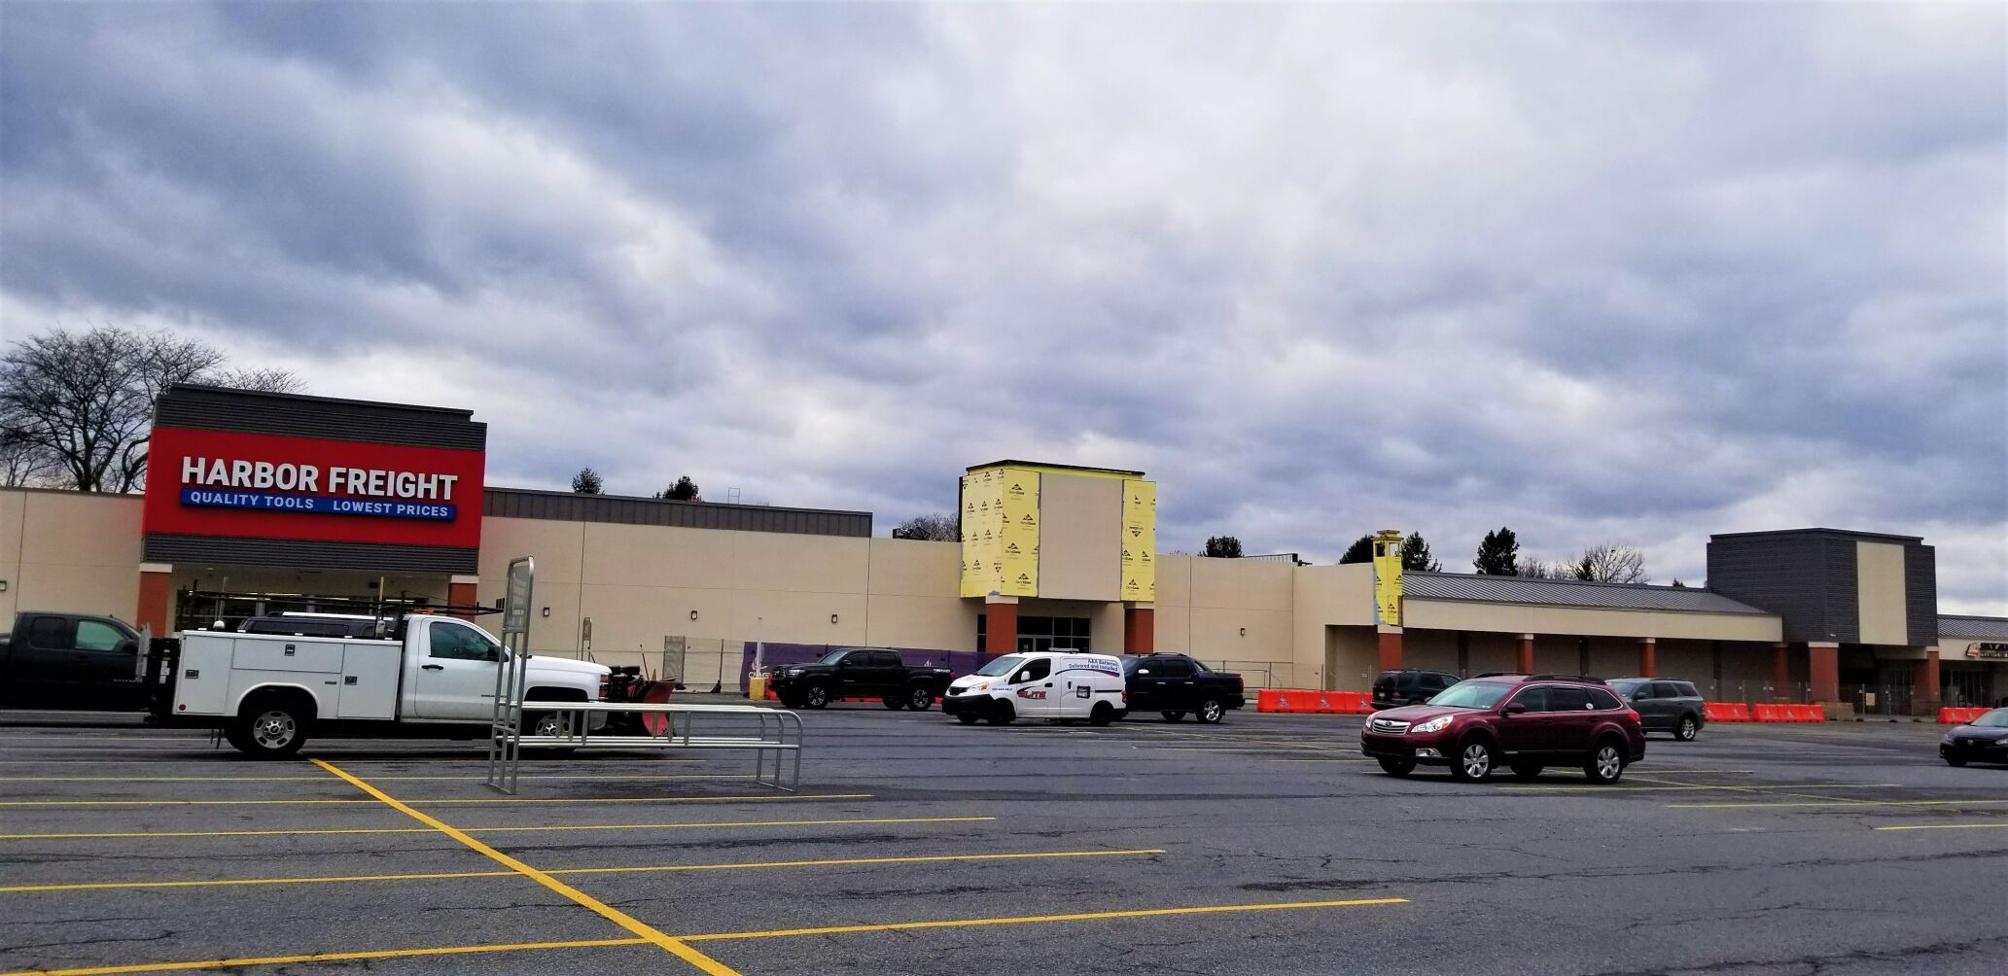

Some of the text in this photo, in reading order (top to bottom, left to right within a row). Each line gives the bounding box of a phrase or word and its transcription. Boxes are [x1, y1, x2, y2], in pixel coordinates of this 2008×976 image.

[181, 456, 458, 500] HARBOR FREIGHT
[190, 491, 448, 517] QUALITY TOOLS LOWEST PRICES
